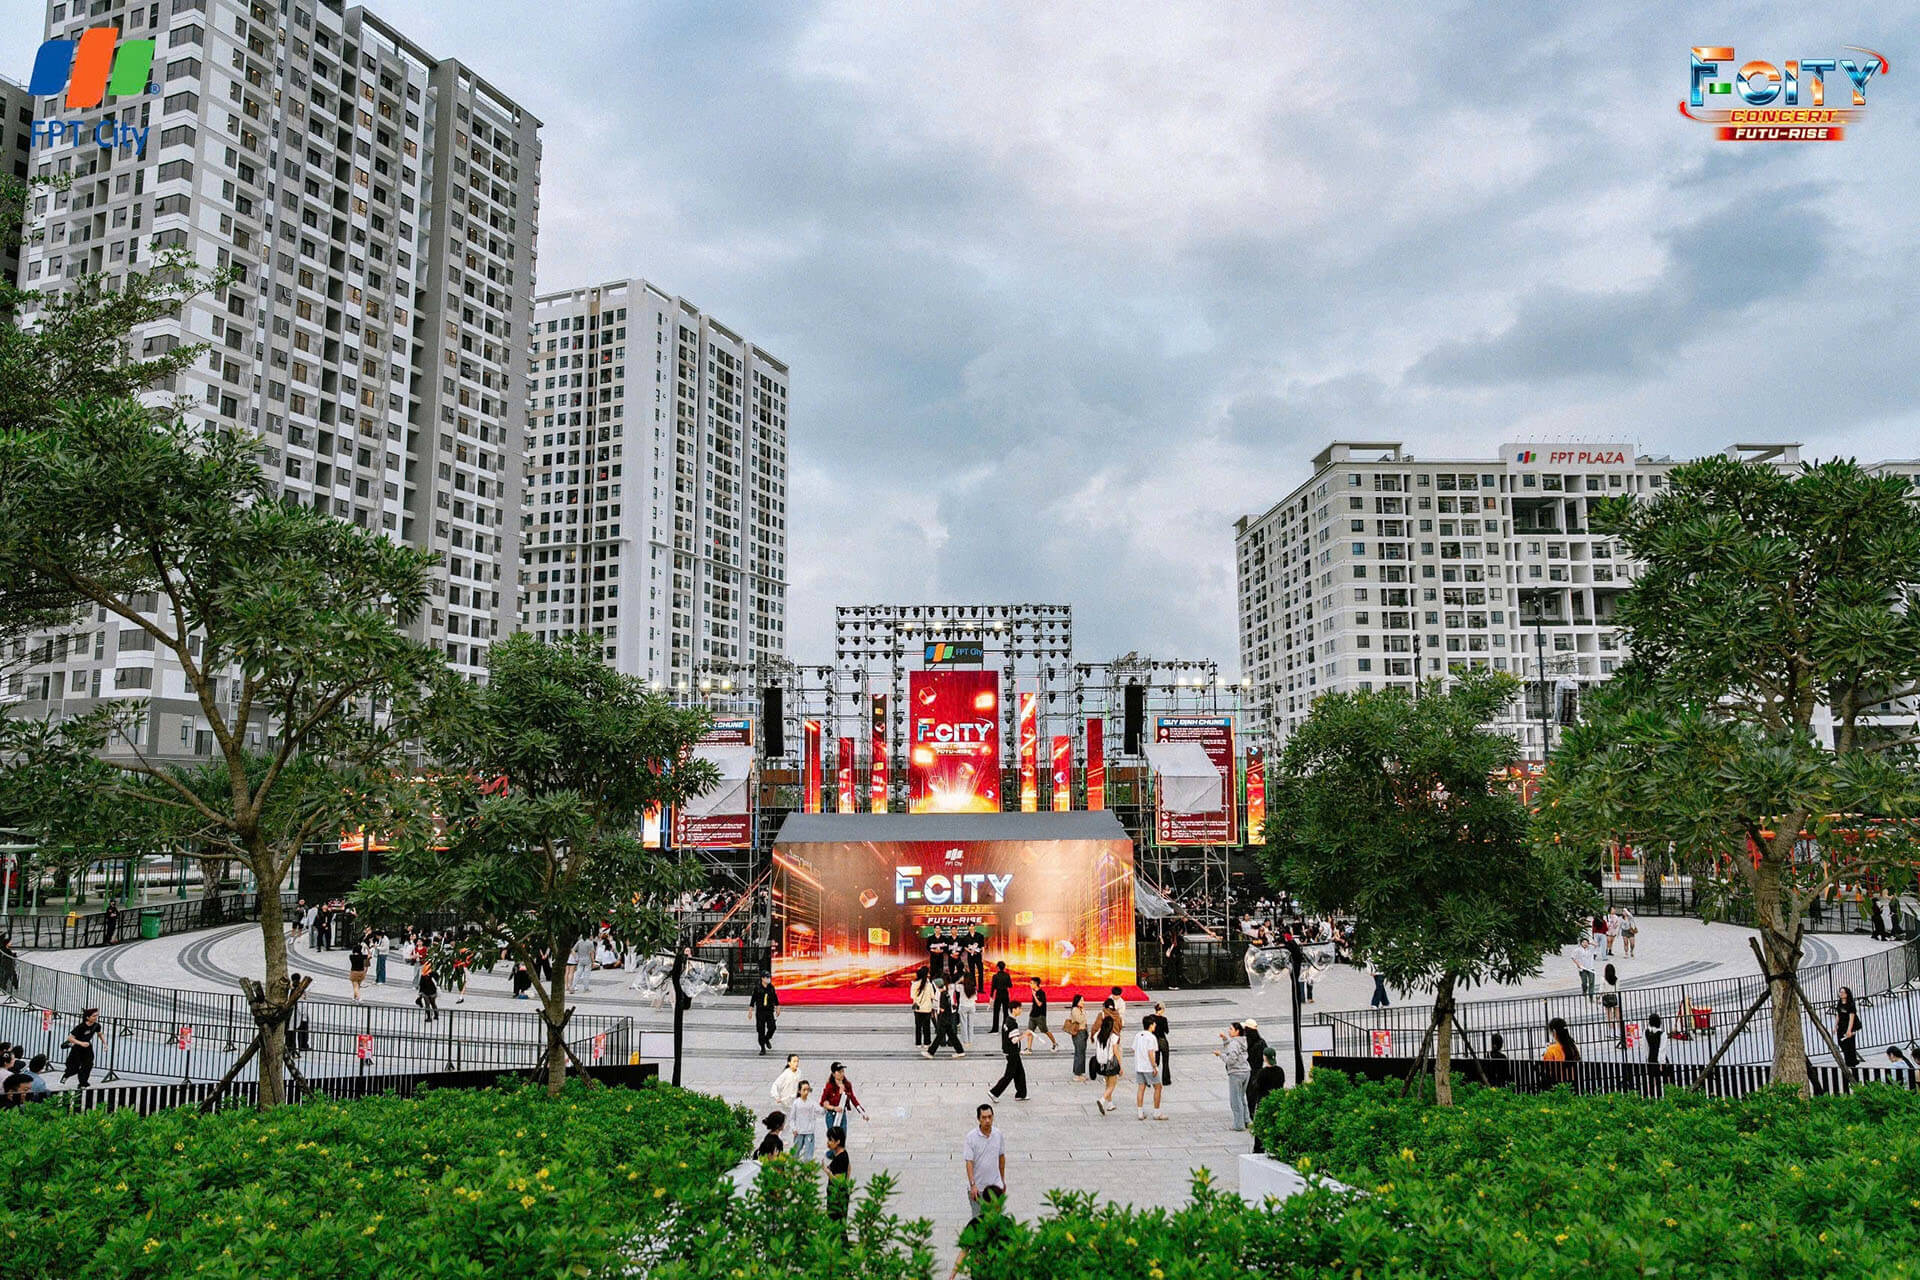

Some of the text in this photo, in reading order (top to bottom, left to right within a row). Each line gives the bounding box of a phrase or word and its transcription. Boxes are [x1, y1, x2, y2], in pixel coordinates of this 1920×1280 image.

[1550, 452, 1625, 464] FPT PLAZA
[956, 647, 983, 657] FPT City
[918, 718, 991, 742] F-CITY
[895, 866, 1013, 905] F-CITY
[924, 905, 984, 914] CONCERT
[928, 916, 982, 924] FUTU-RISE
